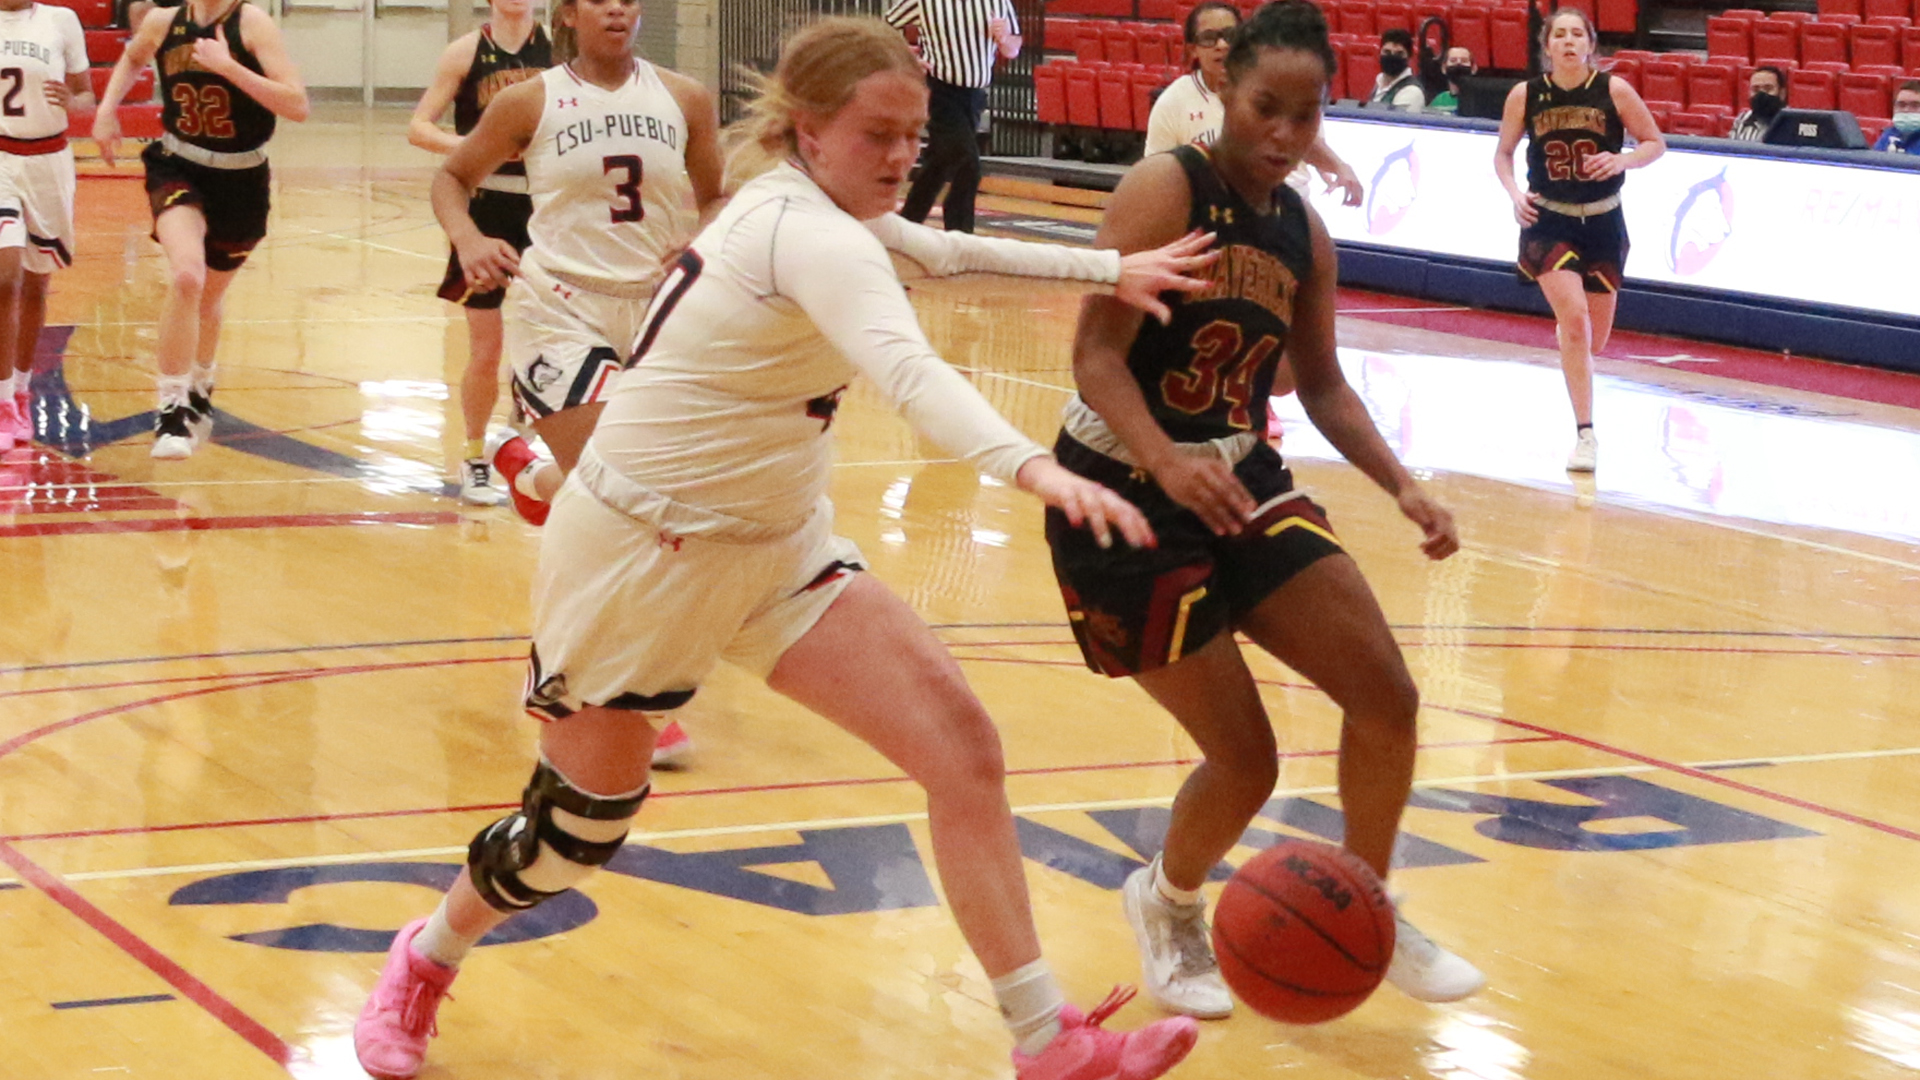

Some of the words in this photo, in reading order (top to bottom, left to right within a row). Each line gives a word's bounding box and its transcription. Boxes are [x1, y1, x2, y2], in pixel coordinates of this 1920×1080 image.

[0, 67, 26, 117] 2
[172, 83, 236, 138] 32
[556, 114, 677, 156] CSU-PUEBLO
[603, 154, 645, 224] 3
[1802, 188, 1920, 231] RE/MA
[1160, 319, 1279, 430] 34
